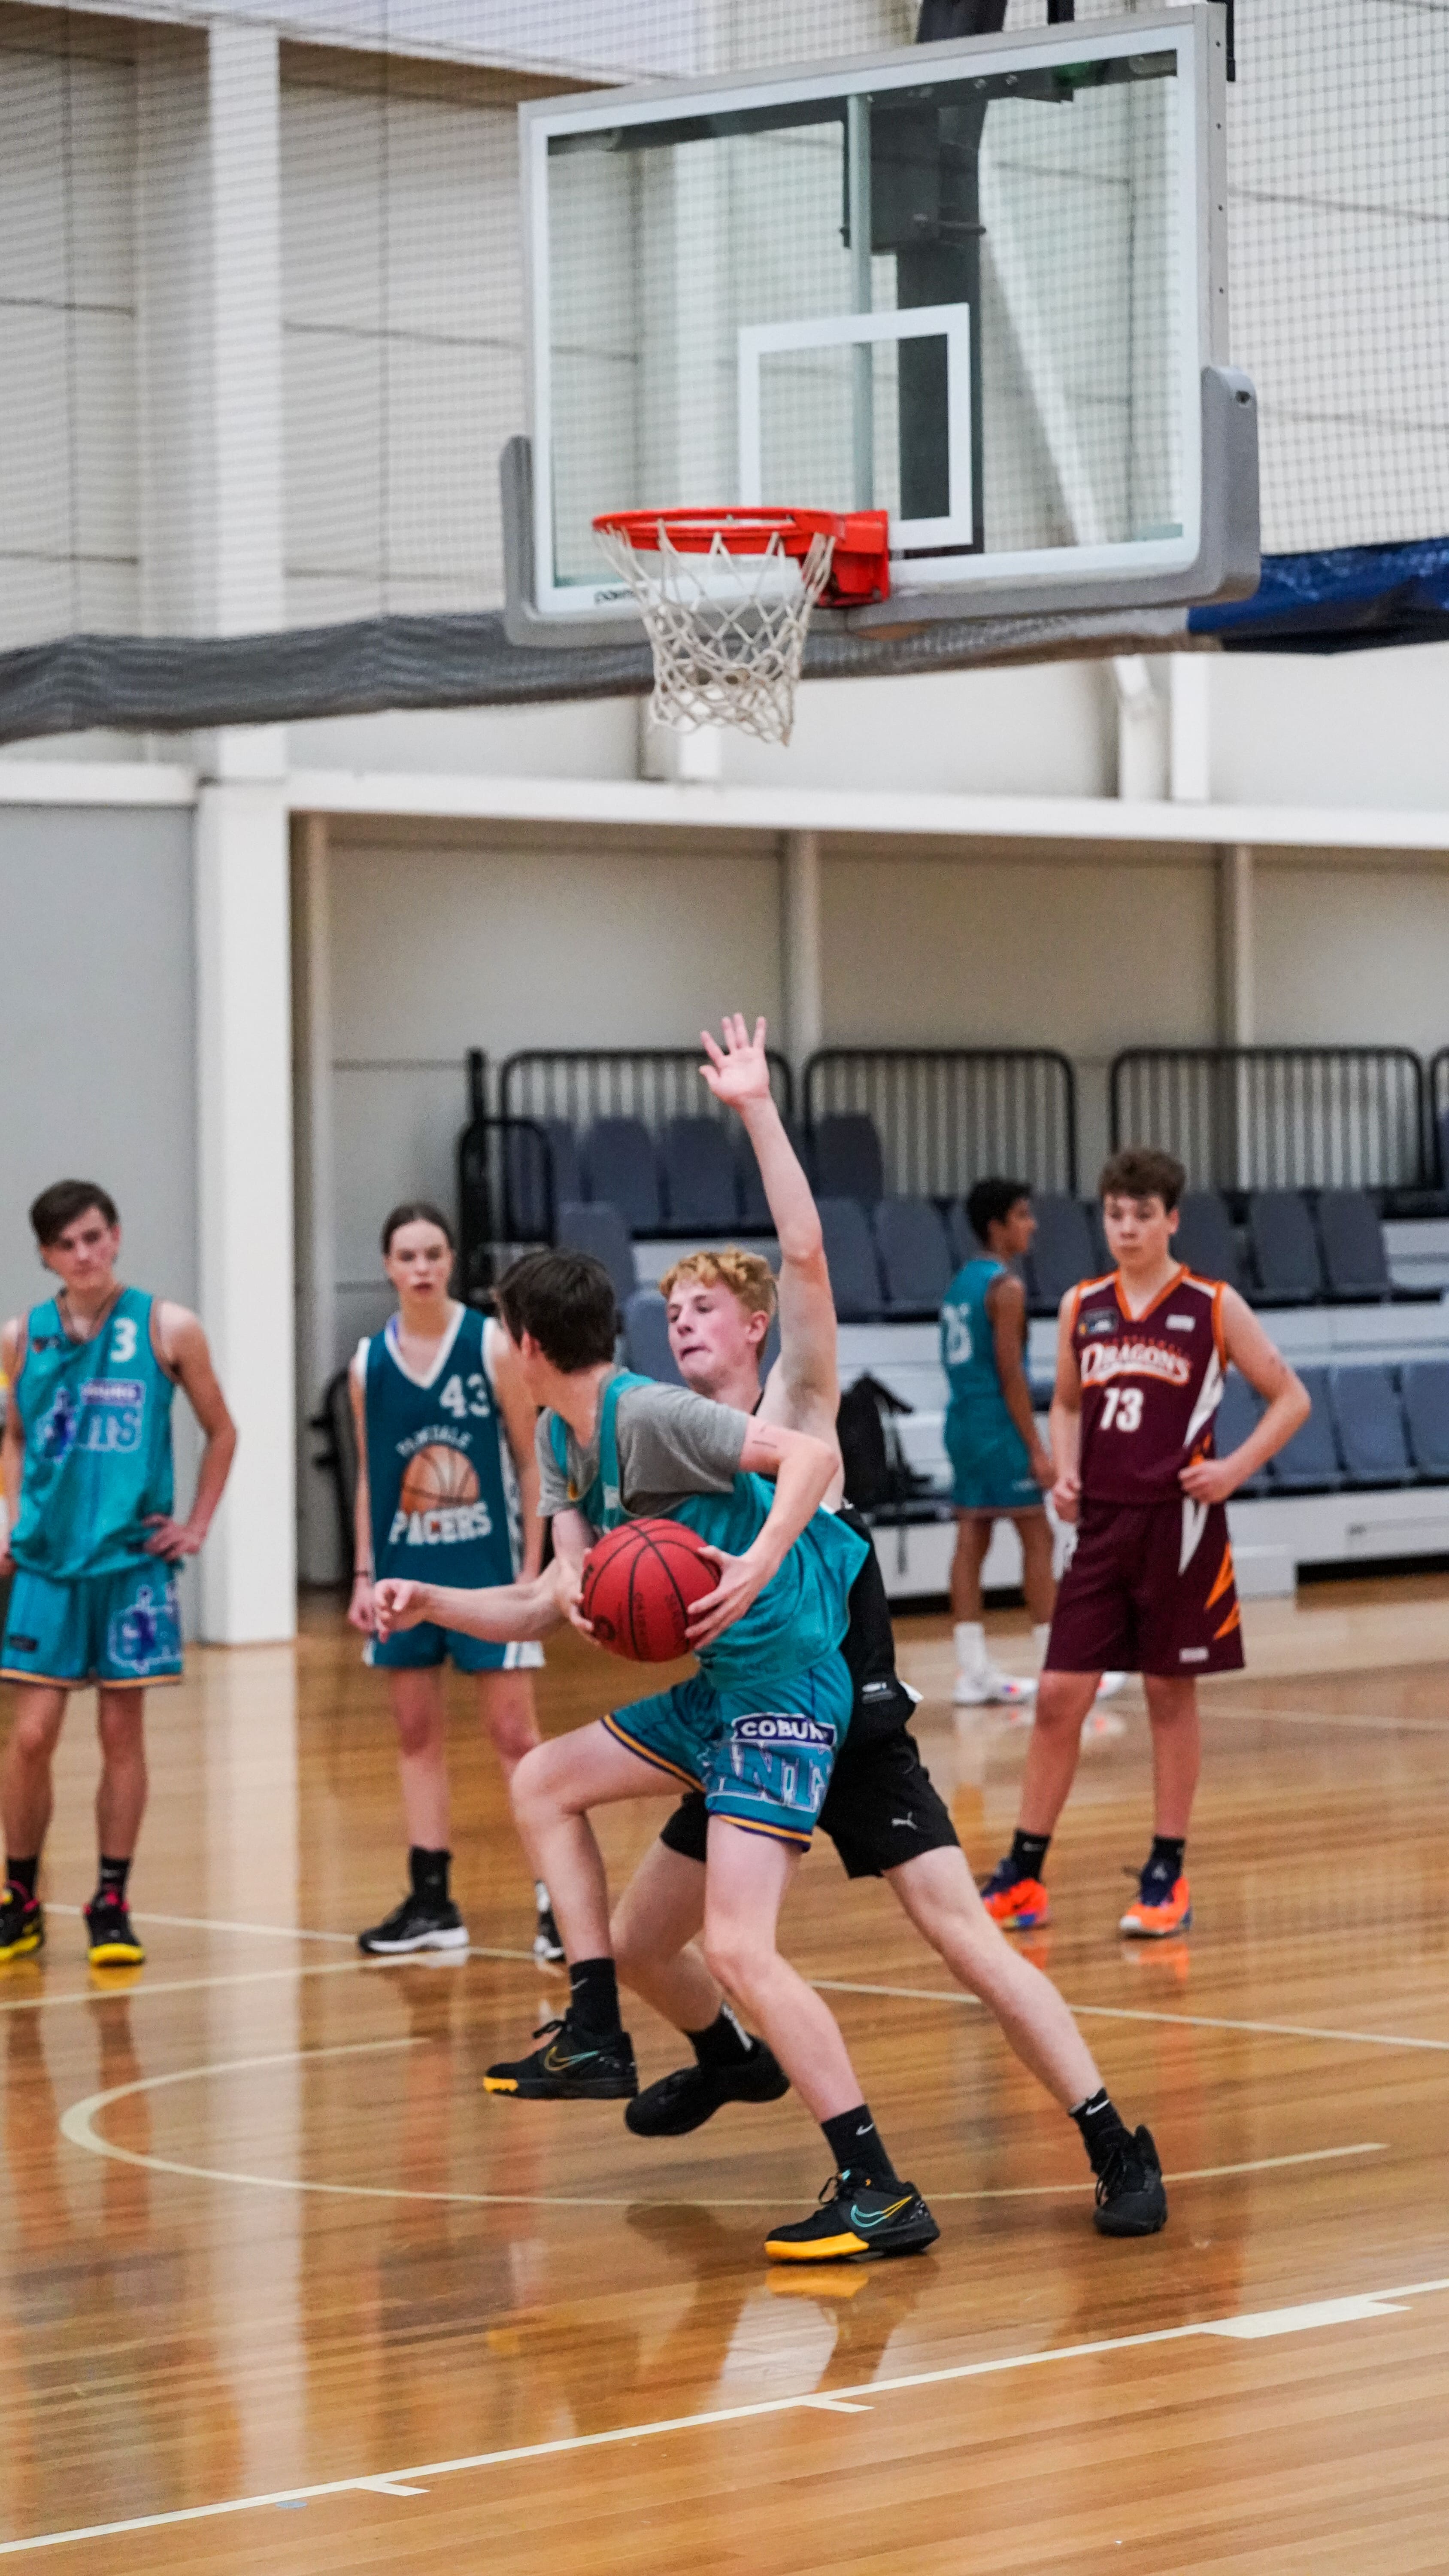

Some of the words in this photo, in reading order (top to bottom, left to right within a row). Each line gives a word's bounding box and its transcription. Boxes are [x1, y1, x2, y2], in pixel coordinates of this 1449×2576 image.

[110, 1318, 137, 1363] 3
[439, 1373, 490, 1419] 43
[1100, 1387, 1145, 1433] 13
[389, 1501, 493, 1546] PACERS
